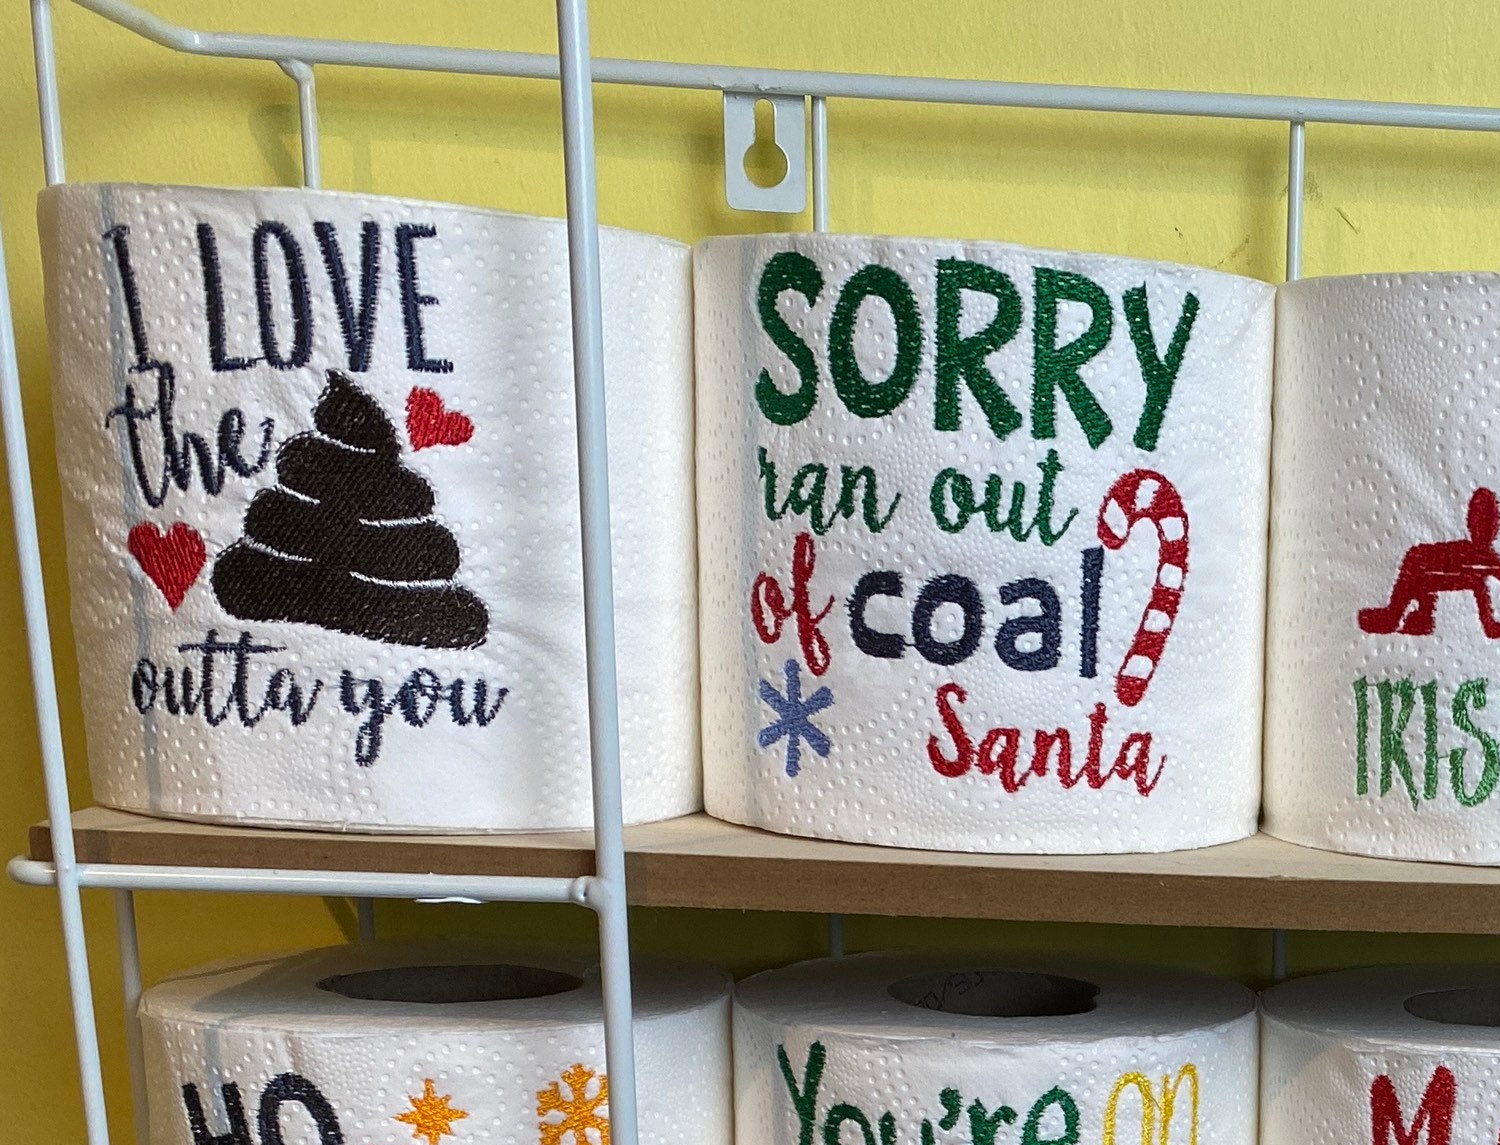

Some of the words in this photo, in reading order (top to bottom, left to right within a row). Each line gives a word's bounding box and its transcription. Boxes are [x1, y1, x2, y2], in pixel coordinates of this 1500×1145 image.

[103, 222, 162, 372] I
[197, 220, 456, 373] LOVE
[755, 250, 1201, 453] SORRY
[105, 360, 275, 508] the
[756, 445, 902, 536] ran
[930, 449, 1080, 546] out
[751, 531, 835, 676] of
[847, 546, 1104, 679] coal
[131, 627, 325, 729] outta
[336, 666, 510, 767] you
[927, 682, 1168, 799] Santa
